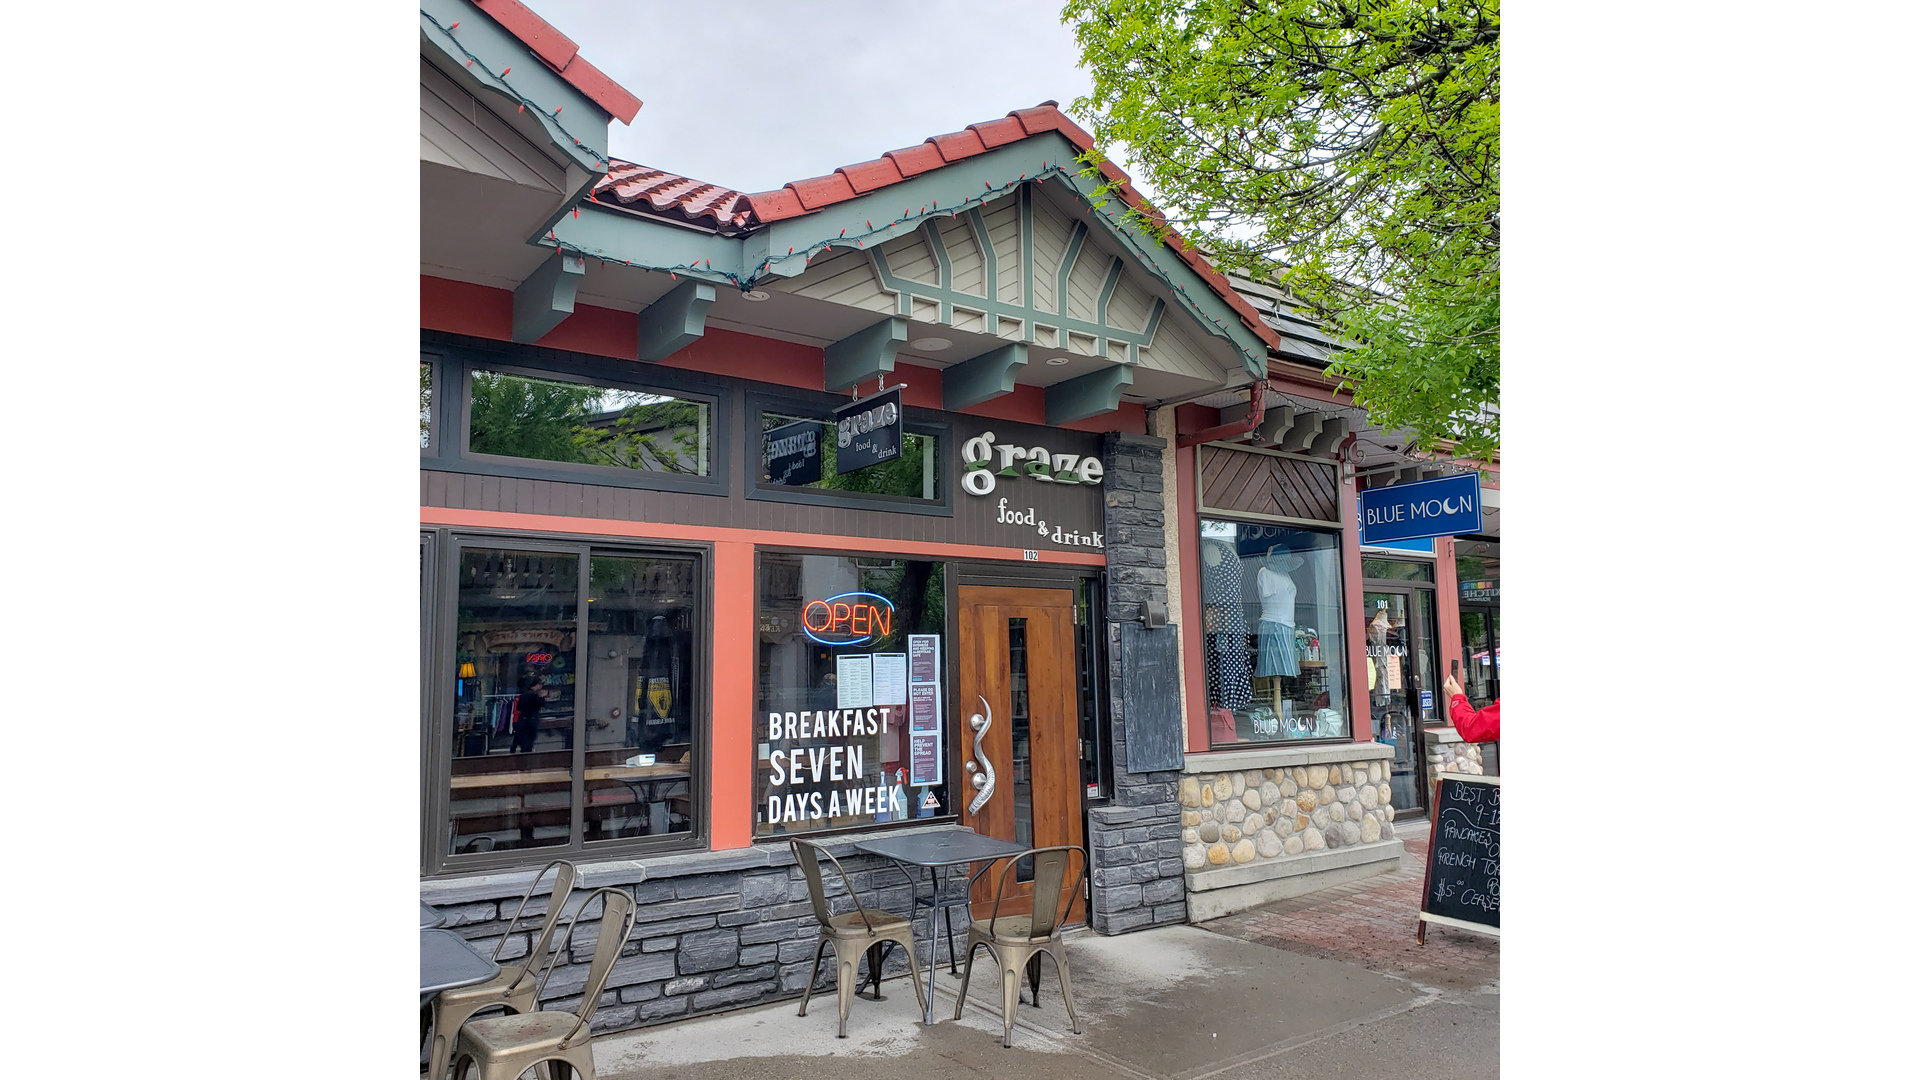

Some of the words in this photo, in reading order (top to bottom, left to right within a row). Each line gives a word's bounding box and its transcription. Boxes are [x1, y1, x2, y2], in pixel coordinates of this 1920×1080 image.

[838, 402, 898, 448] graze
[855, 438, 871, 452] food
[871, 443, 878, 454] &
[878, 445, 897, 459] drink
[961, 431, 1104, 496] graze
[997, 497, 1036, 526] food
[1037, 520, 1050, 537] &
[1051, 525, 1104, 548] drink
[1367, 504, 1405, 526] BLUE
[1411, 494, 1473, 520] MOON
[1024, 550, 1038, 561] 102
[803, 600, 891, 636] OPEN
[1376, 600, 1389, 609] 101
[1366, 645, 1382, 657] BLUE
[769, 708, 890, 740] BREAKFAST
[1253, 718, 1279, 734] BLUE
[1280, 716, 1313, 733] MOON
[769, 744, 863, 786] SEVEN
[768, 791, 822, 824] DAYS
[828, 789, 842, 818] A
[846, 785, 901, 816] WEEK
[1450, 782, 1486, 805] BEST
[1444, 819, 1493, 849] PANCAKES
[1438, 846, 1477, 870] FRENCH
[1460, 888, 1500, 912] CEASE
